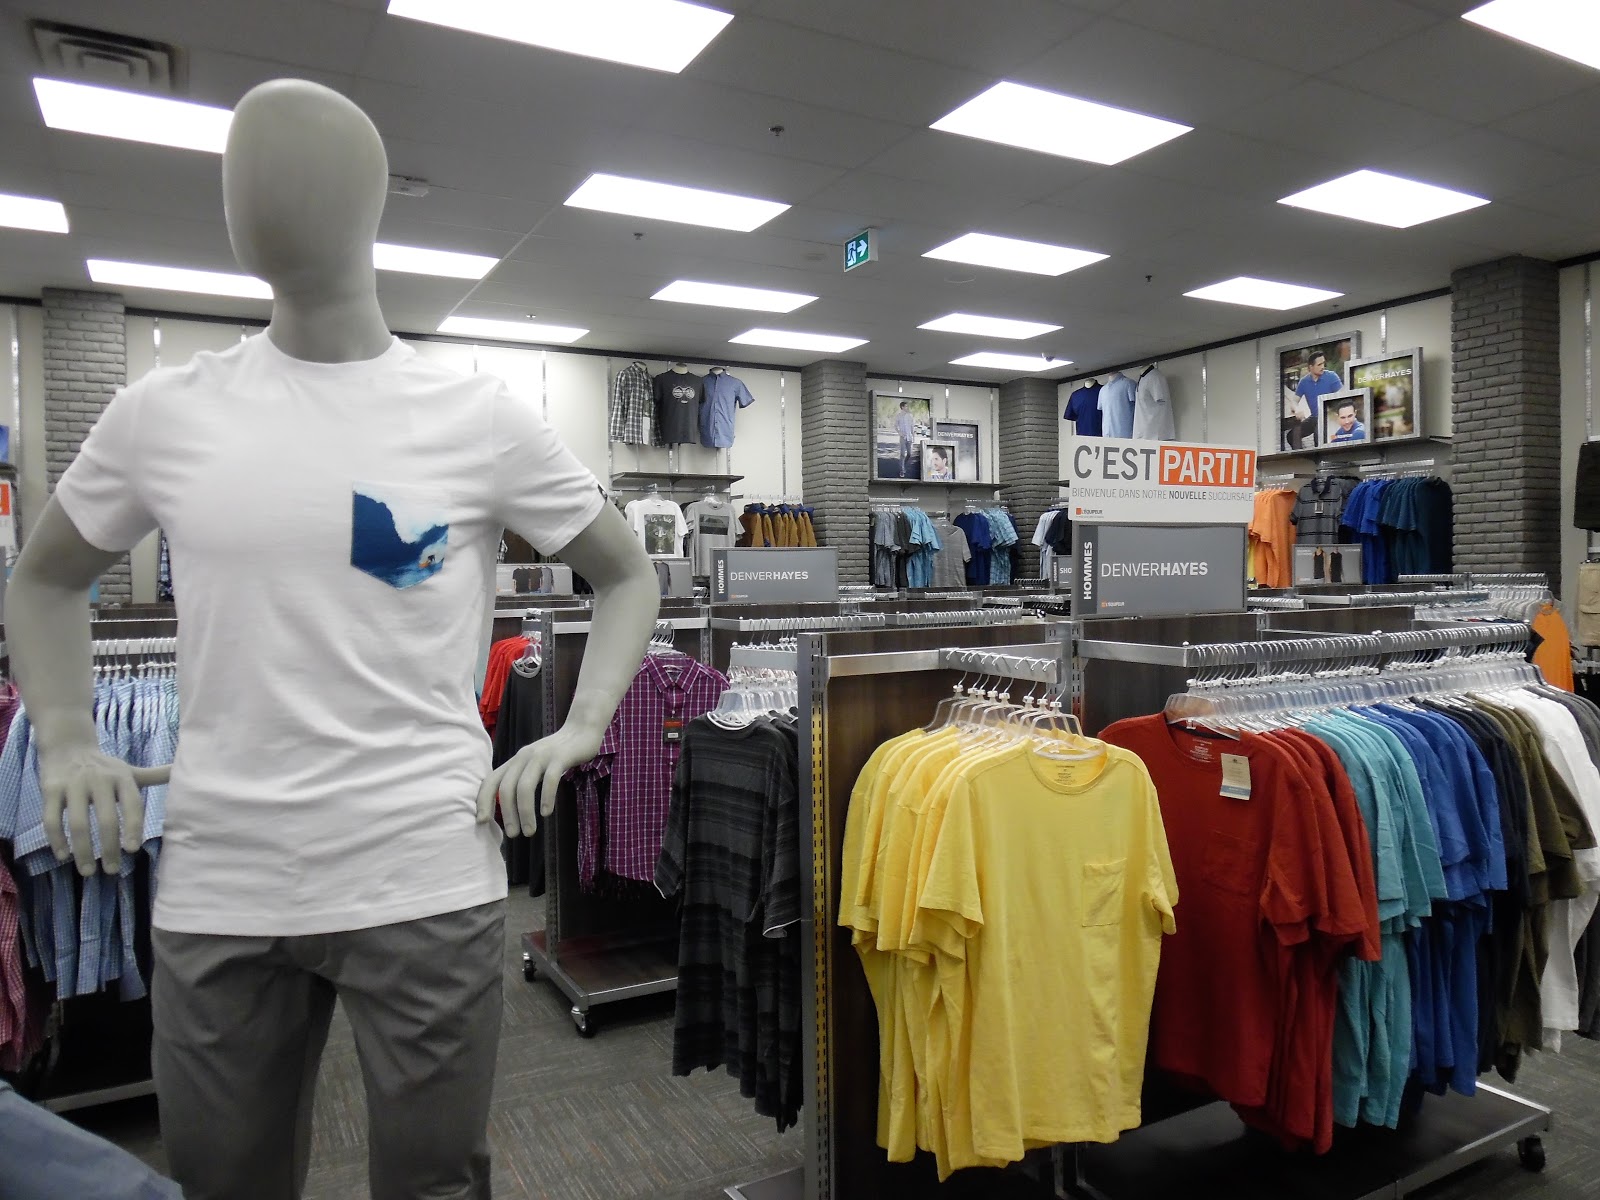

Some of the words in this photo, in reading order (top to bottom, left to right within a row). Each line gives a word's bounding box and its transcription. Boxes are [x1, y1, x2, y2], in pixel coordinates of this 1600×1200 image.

[1073, 444, 1157, 481] C'EST
[1072, 487, 1117, 499] BIENVENUE
[1118, 488, 1141, 499] DANS
[1142, 489, 1167, 500] NOTRE
[1168, 490, 1207, 501] NOUVELLE
[1208, 491, 1253, 502] SUCCURSALE
[1083, 541, 1093, 600] HOMMES
